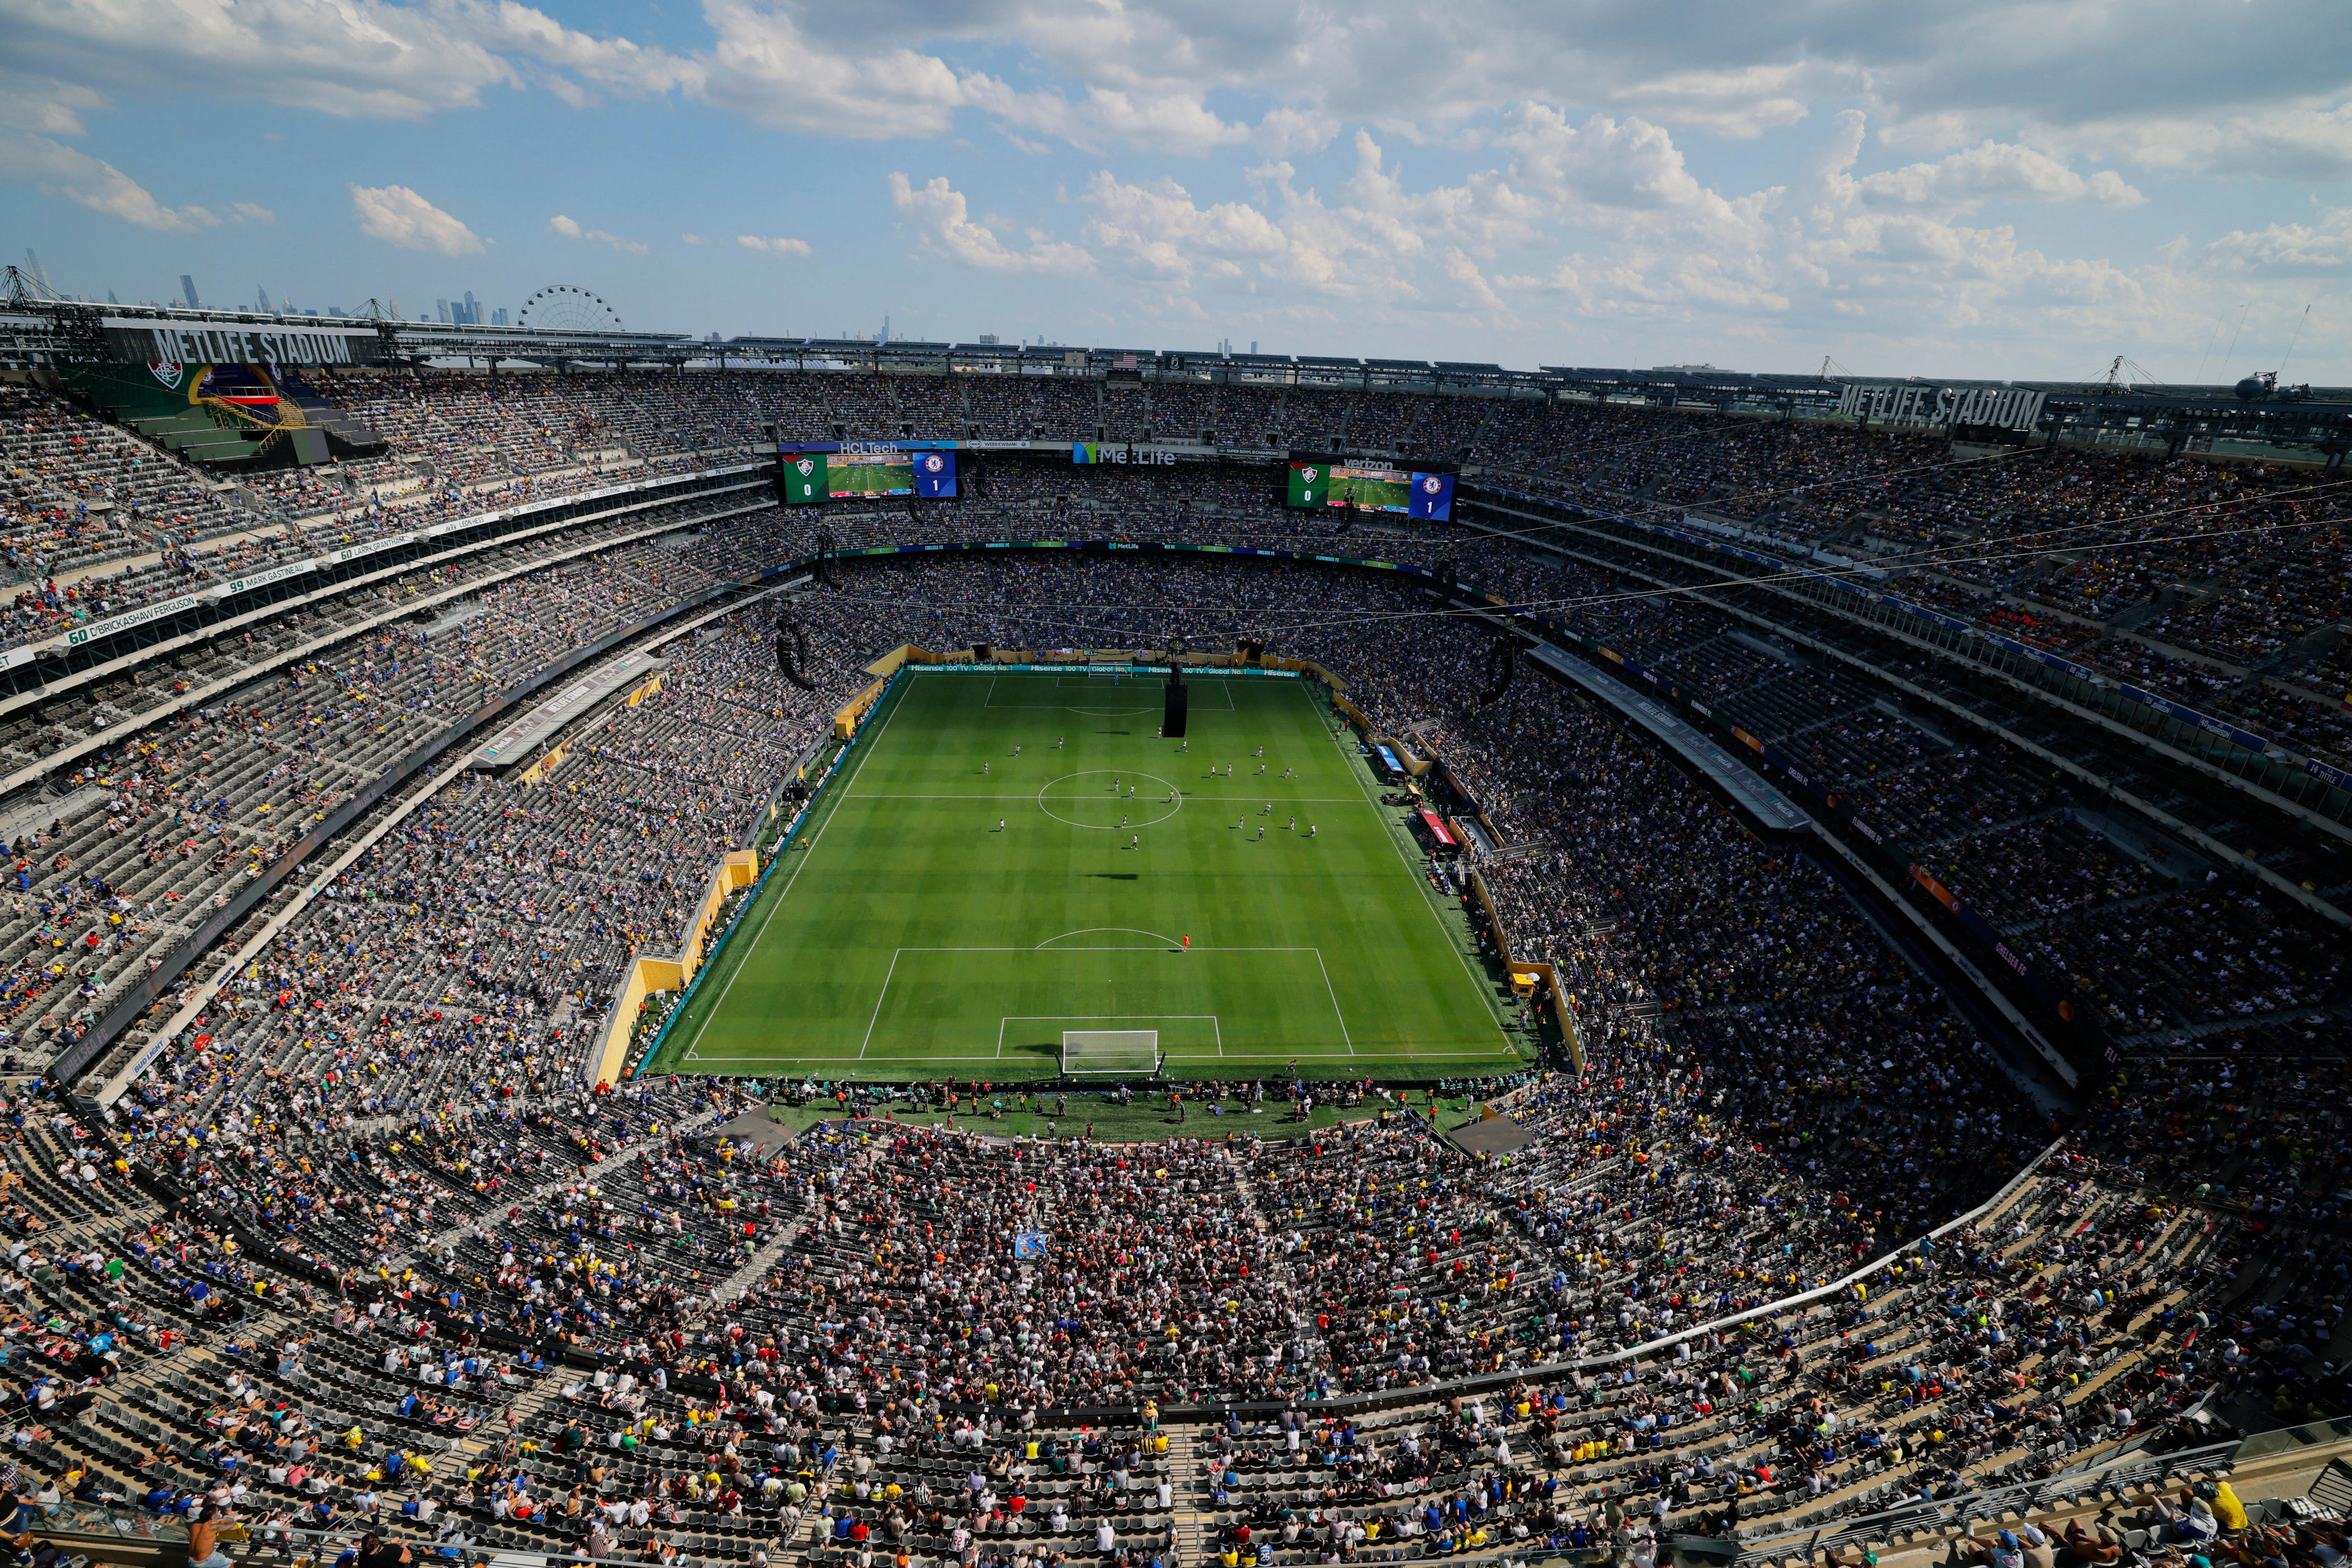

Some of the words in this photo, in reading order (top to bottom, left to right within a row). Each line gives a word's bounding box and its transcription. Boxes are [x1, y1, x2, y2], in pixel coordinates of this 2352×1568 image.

[153, 329, 259, 363] METLIFE
[259, 333, 351, 363] STADIUM
[1837, 385, 1931, 422] METLIFE
[1931, 388, 2047, 429] STADIUM
[840, 442, 898, 454] HCLTech
[1099, 447, 1175, 465] MetLife
[1344, 457, 1393, 471] verizon
[804, 484, 811, 495] 0
[933, 480, 938, 490] 1
[1305, 490, 1311, 501] 0
[526, 503, 545, 511] WINSTON
[1428, 502, 1432, 513] 1
[459, 519, 473, 528] LEON
[473, 517, 484, 525] HESS
[341, 551, 352, 560] 60
[355, 545, 373, 556] LARRY
[373, 536, 405, 551] GRANTHAM
[230, 580, 244, 593] 99
[246, 575, 267, 587] MARK
[268, 564, 304, 580] GASTINEAU
[68, 629, 88, 645] 60
[89, 608, 153, 637] D'BRICKASHAW
[154, 596, 195, 616] FERGUSON
[546, 696, 570, 713] METLIFE
[568, 685, 591, 701] STADIUM
[1691, 699, 1708, 716] FLUMINENSE
[1637, 701, 1659, 716] METLIFE
[1655, 712, 1678, 728] STADIUM
[2151, 702, 2170, 714] JOHNSON
[2200, 719, 2209, 727] 40
[2206, 724, 2231, 739] MORRISON
[493, 736, 514, 749] MetLife
[1714, 754, 1733, 769] MetLife
[1788, 767, 1803, 783] CHELSEA
[1802, 777, 1809, 786] FC
[2310, 764, 2319, 773] 14
[2319, 771, 2337, 783] TITTLE
[1774, 801, 1794, 818] MetLife
[1852, 816, 1877, 840] FLUMINENSE
[1875, 834, 1883, 845] FC
[729, 903, 749, 935] Hisense
[1995, 941, 2019, 969] CHELSEA
[2017, 962, 2027, 976] FC
[688, 971, 706, 997] Global
[92, 1339, 103, 1348] 43
[400, 1399, 407, 1408] 8
[954, 1536, 962, 1546] 22
[1260, 1553, 1270, 1561] 25
